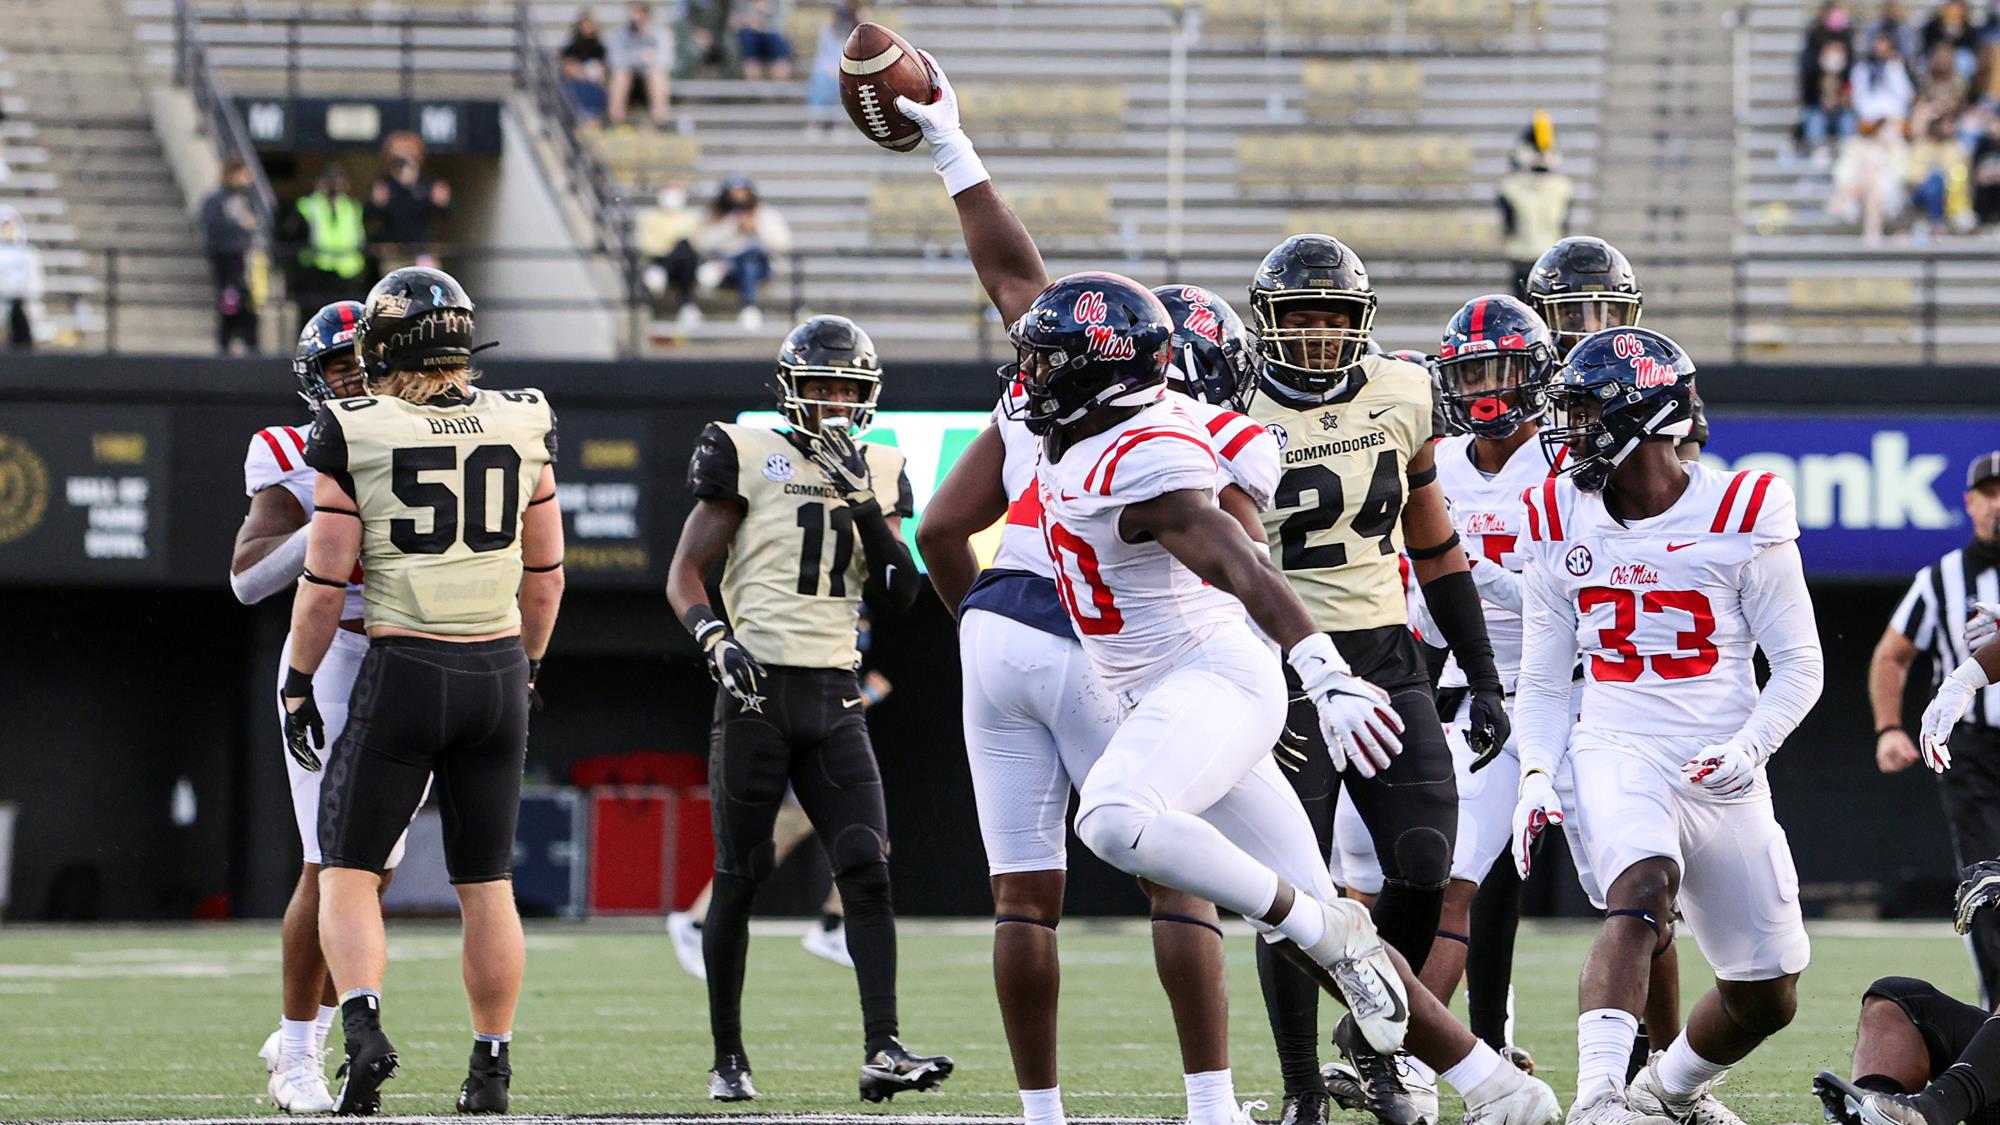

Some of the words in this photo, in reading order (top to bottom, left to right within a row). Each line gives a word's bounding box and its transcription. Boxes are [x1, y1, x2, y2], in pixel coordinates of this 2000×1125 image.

[1074, 291, 1108, 325] Ole
[1085, 324, 1136, 361] Miss
[1612, 333, 1645, 360] Ole
[1630, 356, 1680, 389] Miss
[427, 415, 485, 435] BARR
[1286, 431, 1386, 464] COMMODORES
[390, 443, 522, 555] 50
[1274, 449, 1403, 571] 24
[797, 502, 855, 597] 11
[1566, 546, 1592, 575] SEC
[1610, 565, 1630, 586] Ole
[1629, 564, 1661, 585] Miss
[1577, 586, 1719, 682] 33
